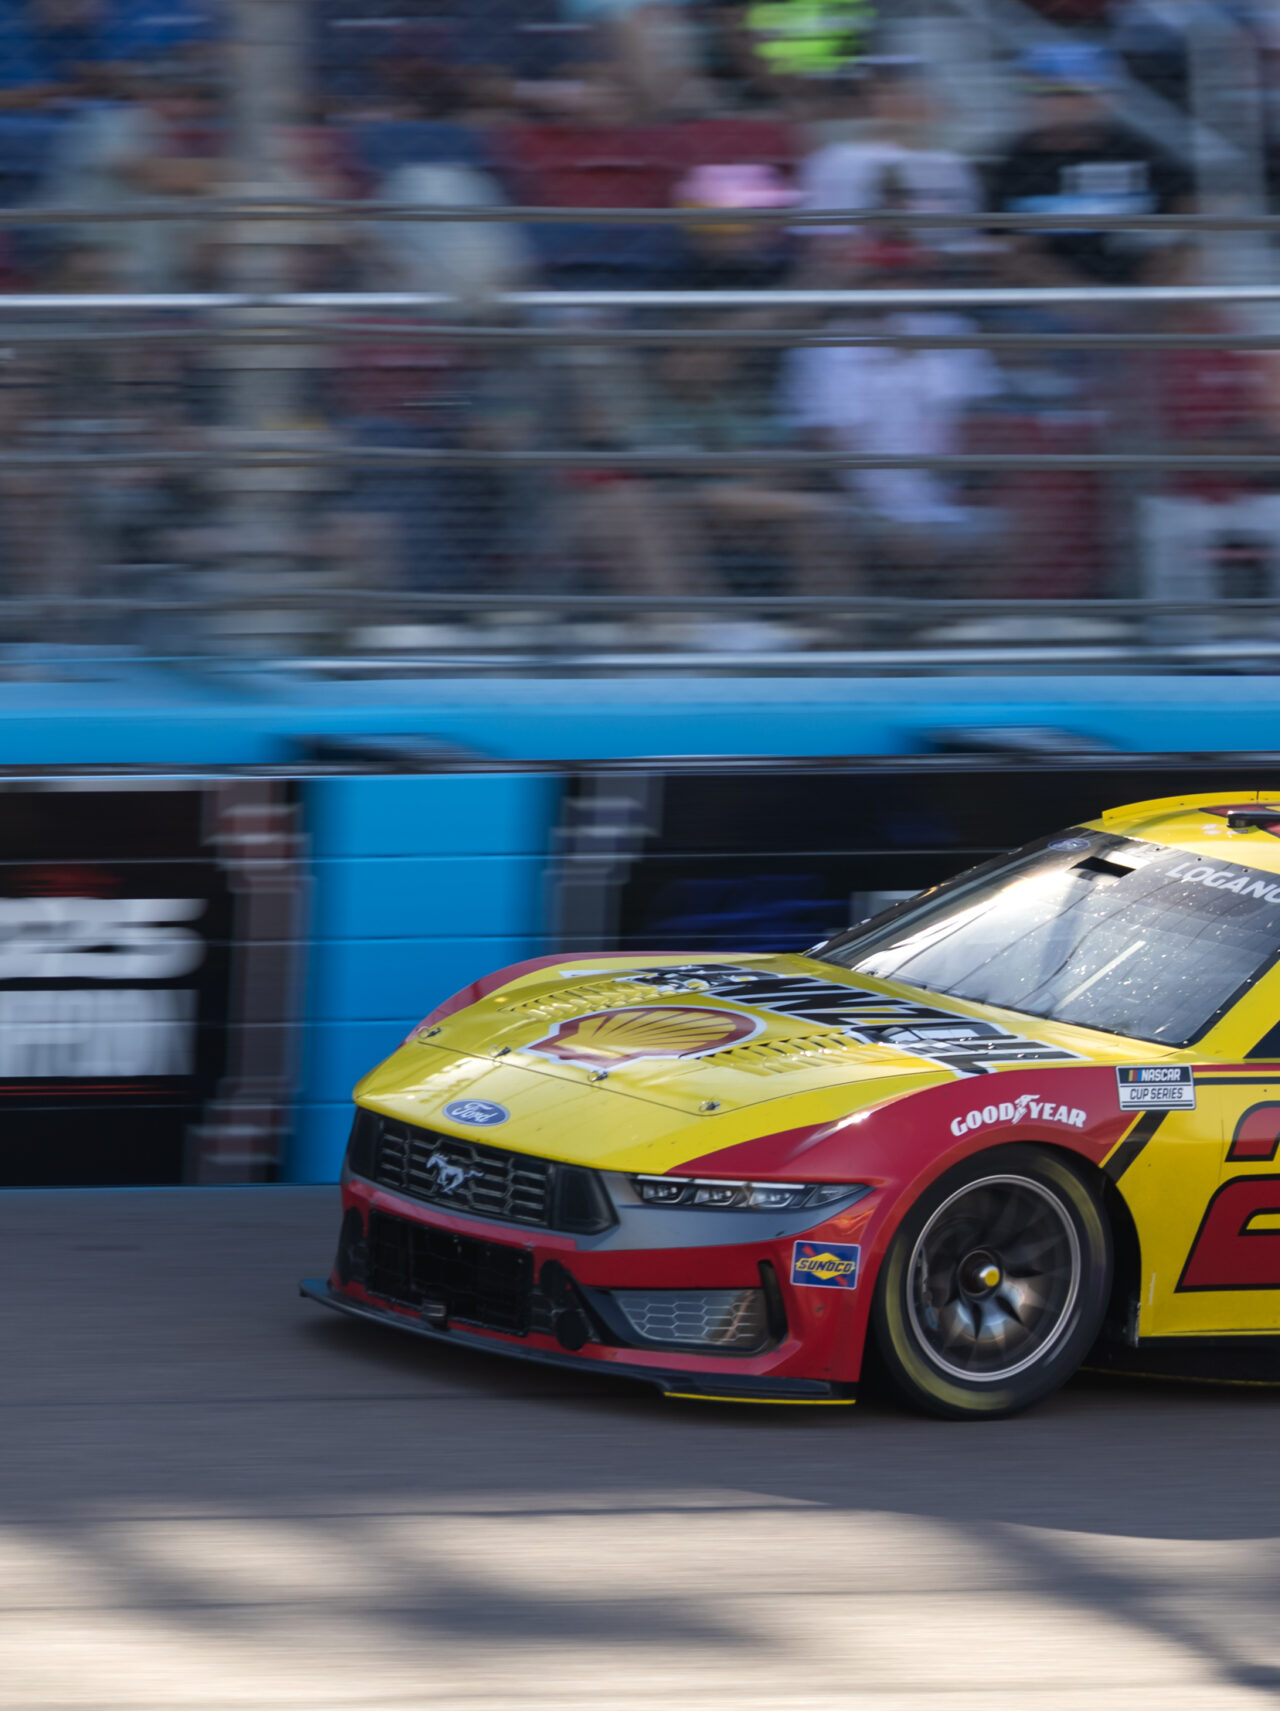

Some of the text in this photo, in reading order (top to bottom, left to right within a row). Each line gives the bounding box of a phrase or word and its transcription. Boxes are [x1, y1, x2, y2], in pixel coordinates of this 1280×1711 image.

[1141, 1068, 1181, 1082] NASCAR
[1130, 1087, 1183, 1100] CUP SERIES
[451, 1102, 499, 1123] Ford
[950, 1096, 1087, 1137] GOODYEAR
[798, 1259, 853, 1273] SUNOCO
